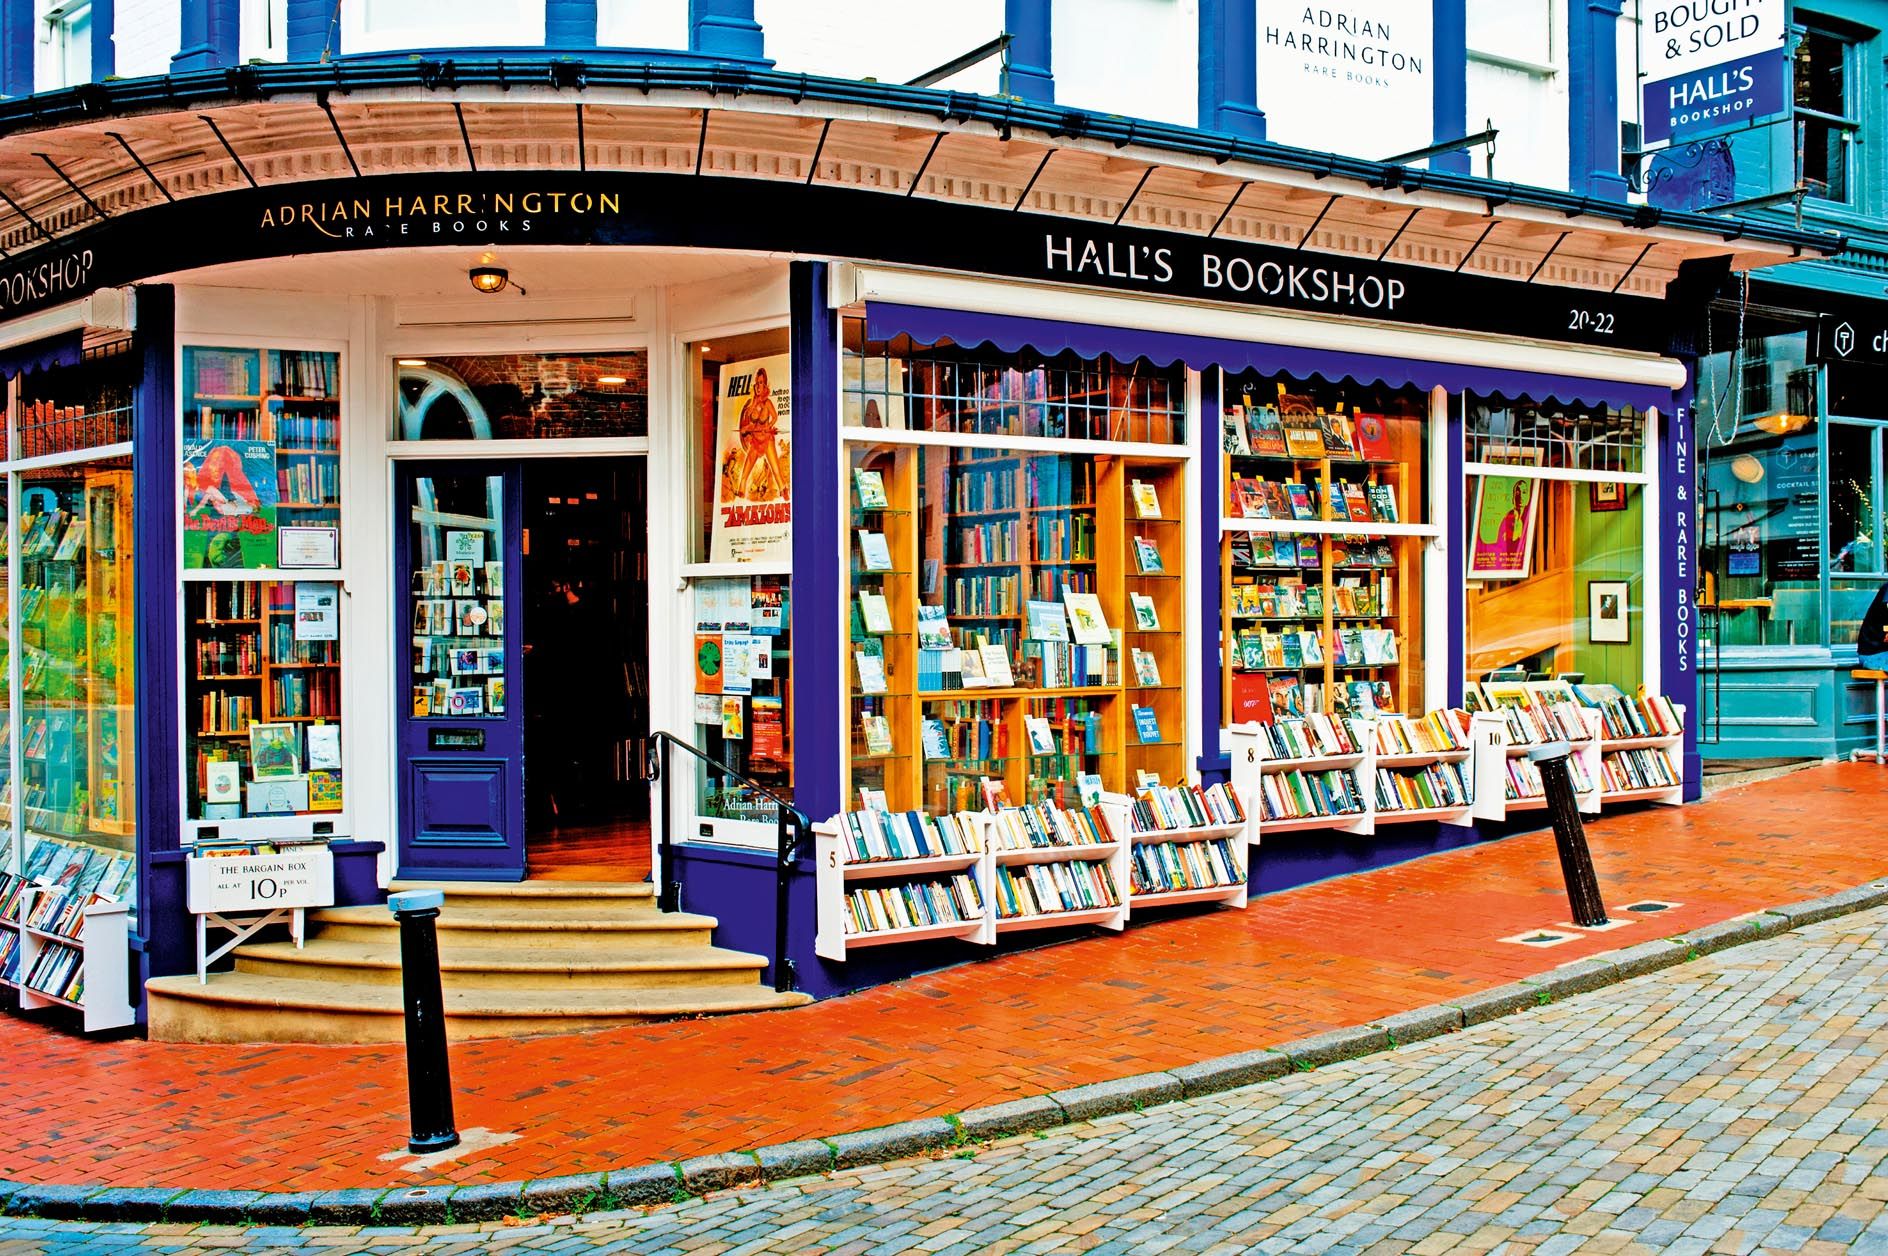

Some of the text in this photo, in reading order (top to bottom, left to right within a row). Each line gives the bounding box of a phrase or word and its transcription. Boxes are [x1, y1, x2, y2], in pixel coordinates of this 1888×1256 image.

[1302, 7, 1390, 41] ADRIAN
[1655, 0, 1762, 33] BOUG
[1665, 14, 1760, 59] & SOLD
[1266, 26, 1422, 74] HARRINGTON
[1304, 63, 1389, 88] RARE BOOKS
[1669, 66, 1754, 109] HALL'S
[1669, 98, 1754, 127] BOOKSHOP
[260, 199, 370, 238] ADRIAN
[345, 219, 532, 237] RAE BOOKS
[1045, 233, 1405, 311] HALL'S BOOKSHOP
[1568, 309, 1615, 334] 20-22
[727, 374, 752, 397] HELL
[1776, 481, 1809, 489] COCKTAIL
[1676, 408, 1689, 672] FINE & RARE BOOKS
[1489, 732, 1501, 746] 10
[1247, 747, 1255, 763] 8
[724, 798, 752, 810] Adrian
[220, 862, 307, 875] THE BARGAIN BOX
[829, 851, 836, 868] 5
